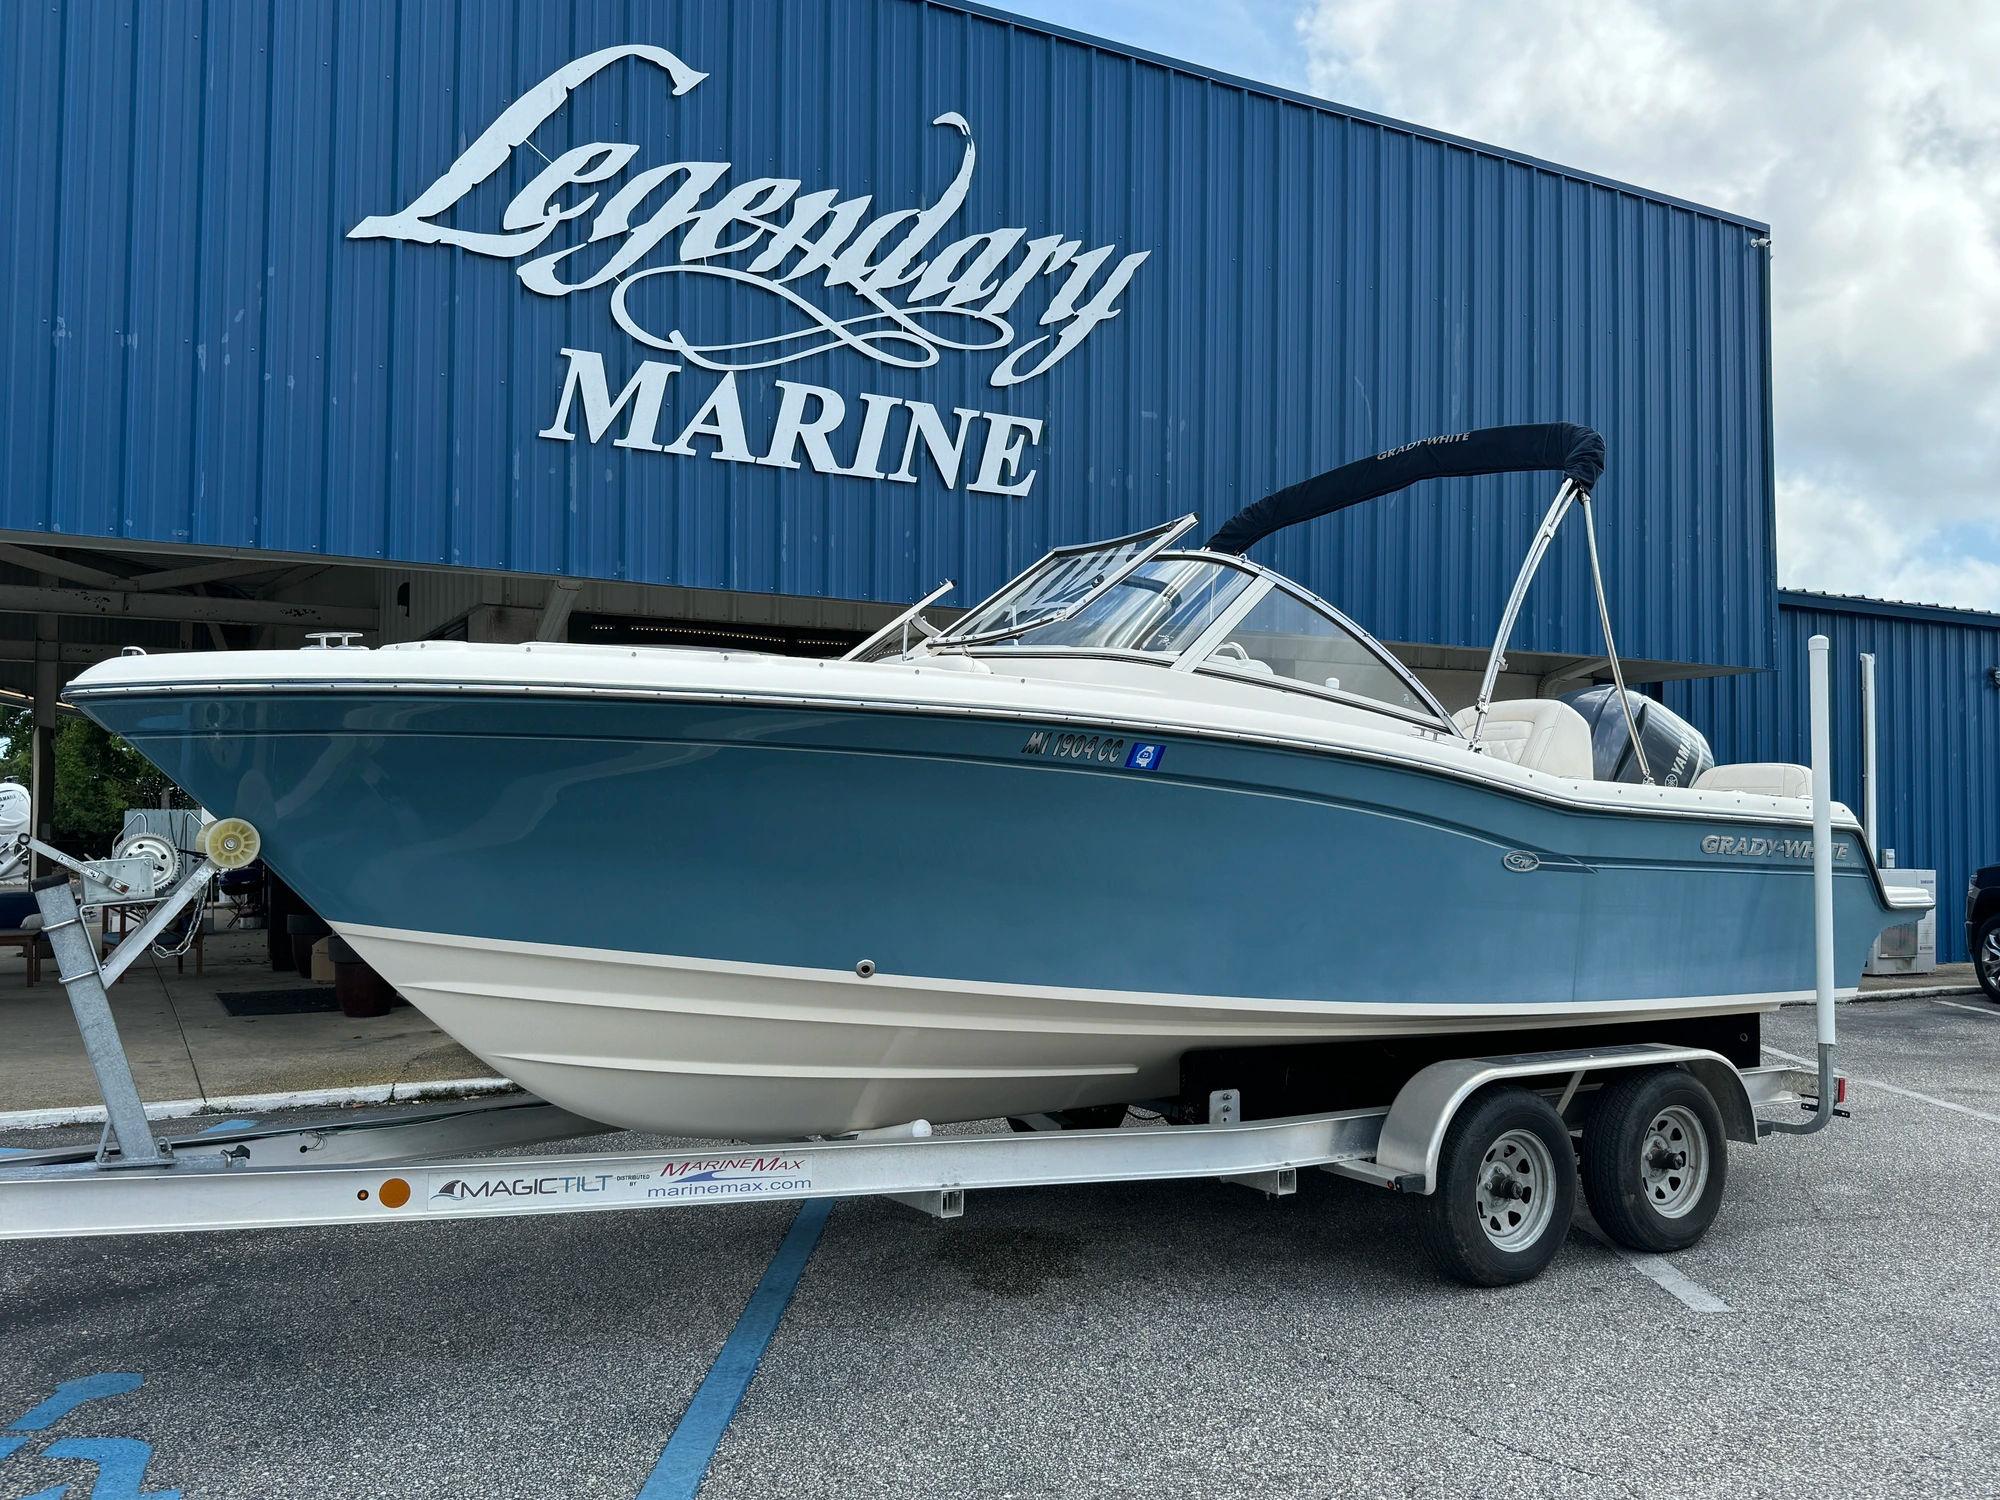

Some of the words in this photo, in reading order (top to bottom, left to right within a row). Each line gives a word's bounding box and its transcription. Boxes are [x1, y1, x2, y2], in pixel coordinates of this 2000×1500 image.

[347, 43, 1151, 388] Legendary
[538, 347, 1044, 498] MARINE
[1021, 731, 1052, 755] MI
[1052, 733, 1099, 760] 1904
[1097, 738, 1125, 763] CC
[1670, 735, 1691, 776] YAMA
[1700, 834, 1850, 861] GRADY-WHTE
[647, 1178, 812, 1198] marinemax.com
